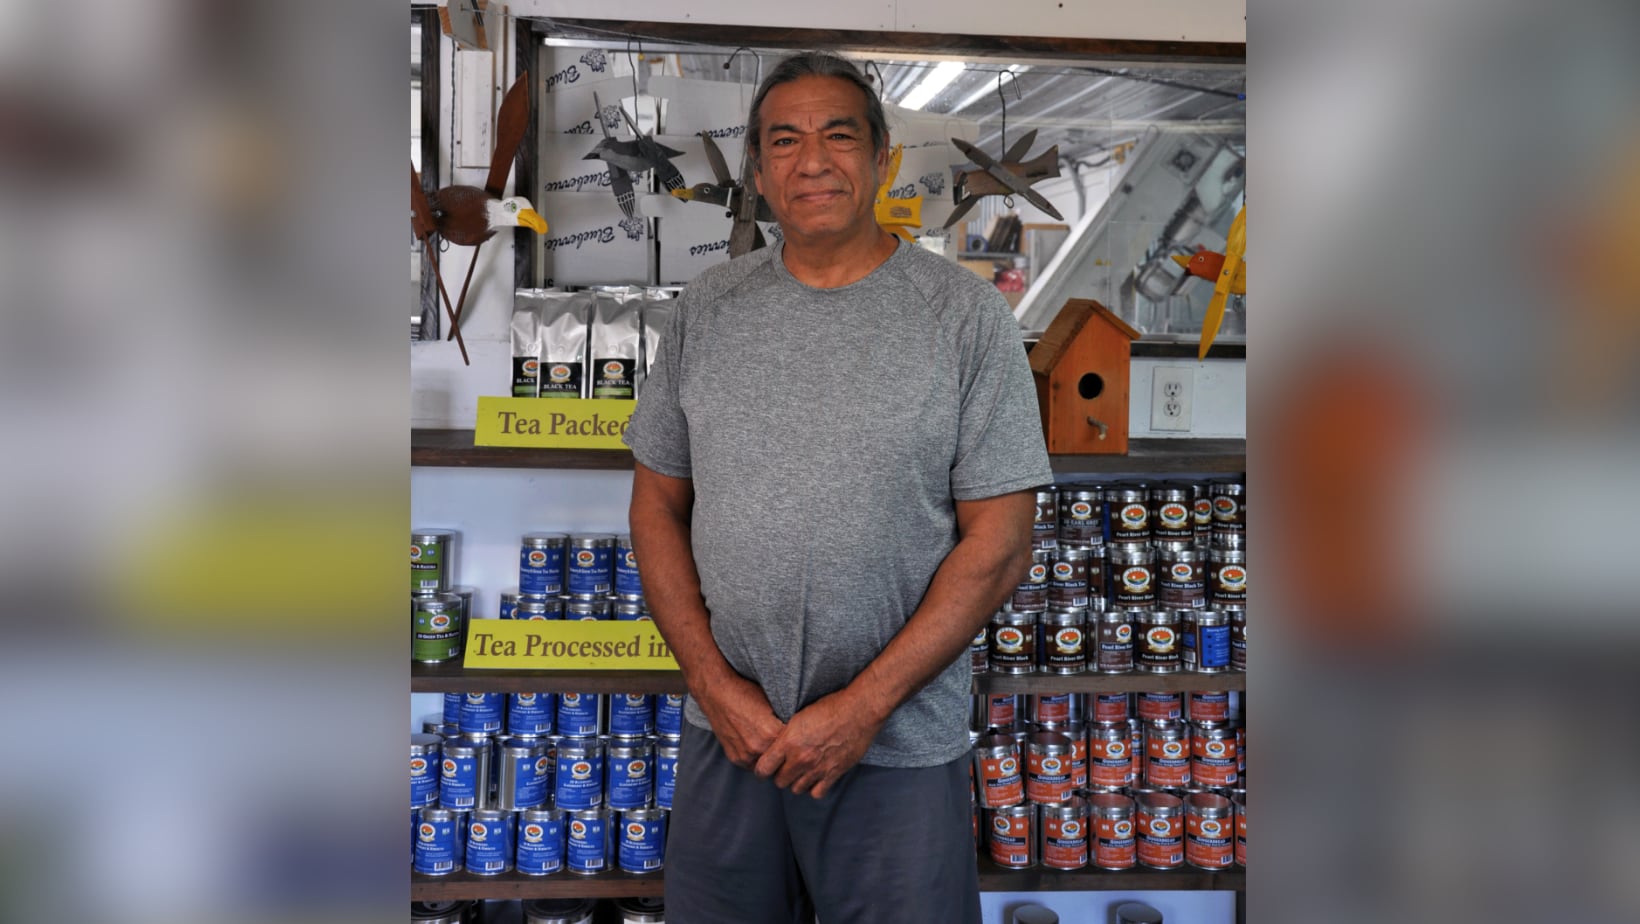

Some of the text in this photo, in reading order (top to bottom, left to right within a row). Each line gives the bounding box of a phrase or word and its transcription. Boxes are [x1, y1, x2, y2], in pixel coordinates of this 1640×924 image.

[498, 411, 540, 435] Tea
[474, 633, 516, 657] Tea
[523, 632, 641, 657] Processed
